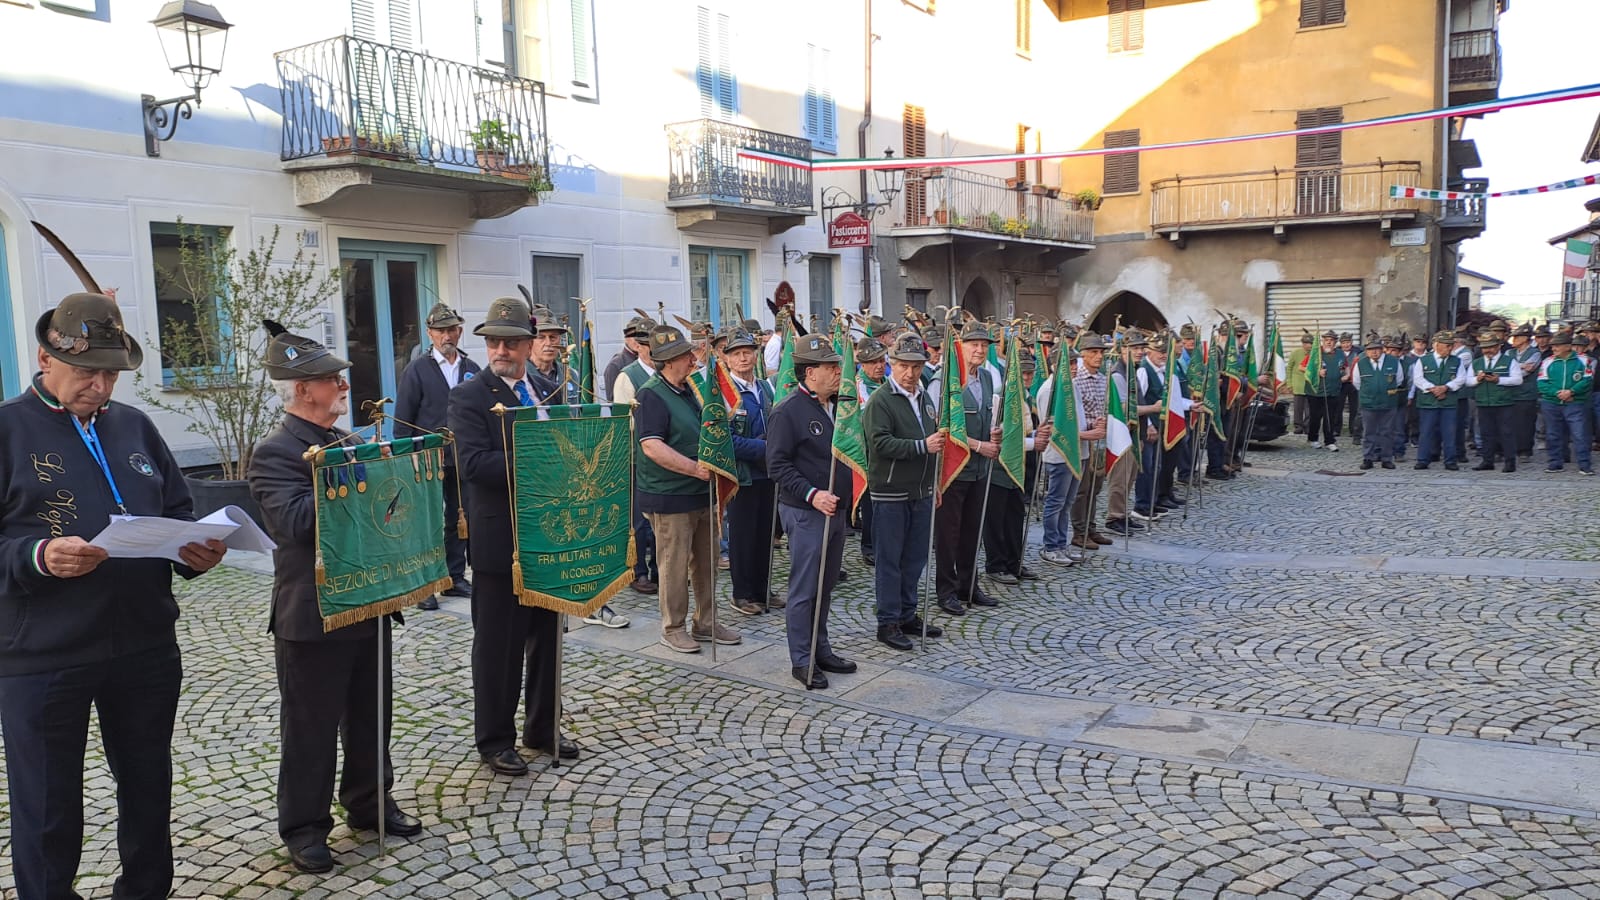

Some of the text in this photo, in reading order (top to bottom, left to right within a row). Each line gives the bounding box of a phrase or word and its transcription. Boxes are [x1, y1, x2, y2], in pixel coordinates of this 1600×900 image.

[831, 223, 867, 237] Pasticceria
[30, 453, 66, 483] La
[538, 554, 555, 565] FRA
[559, 549, 591, 563] MILITARI
[598, 545, 617, 557] ALPINI
[325, 566, 380, 596] SEZIONE
[382, 563, 392, 580] DI
[569, 563, 605, 579] CONGEDO
[570, 582, 598, 595] TORINO
